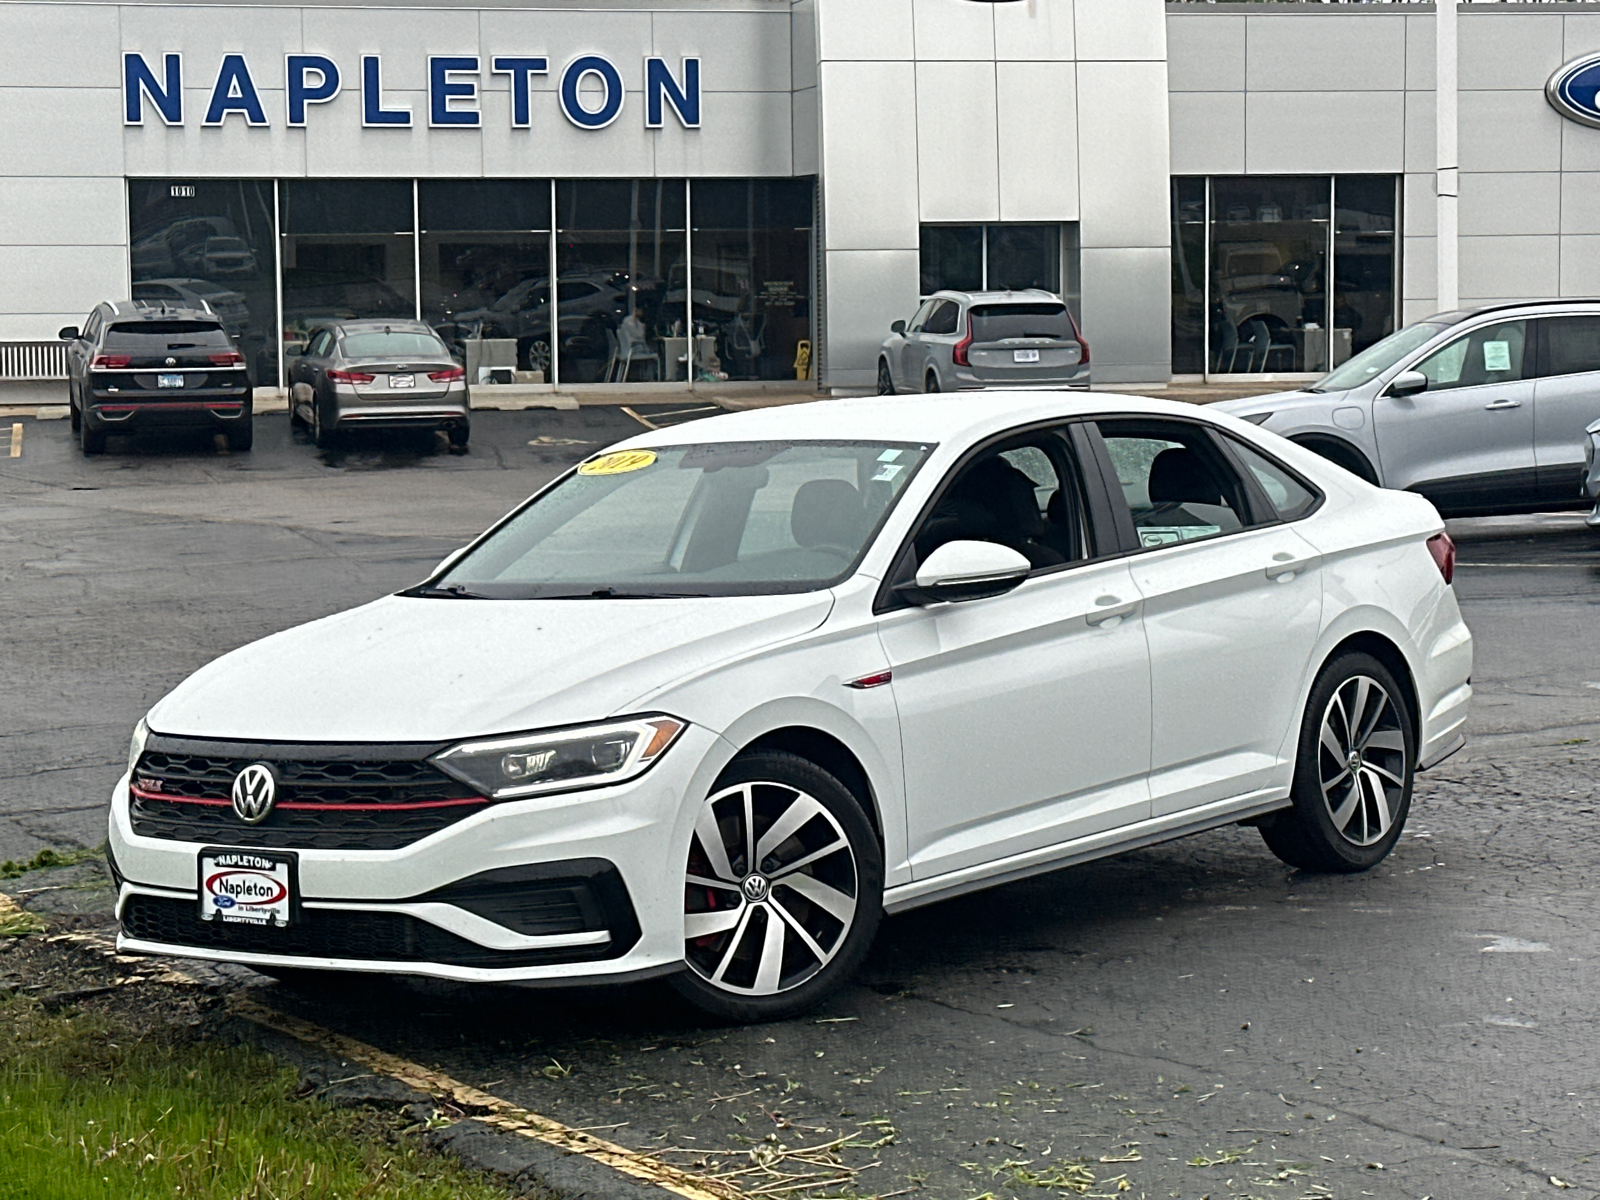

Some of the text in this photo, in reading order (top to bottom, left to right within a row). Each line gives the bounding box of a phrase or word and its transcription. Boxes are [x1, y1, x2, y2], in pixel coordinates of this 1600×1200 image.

[121, 52, 701, 129] NAPLETON
[171, 185, 195, 197] 1010
[218, 854, 269, 869] NAPLETON
[219, 877, 274, 898] Napleton
